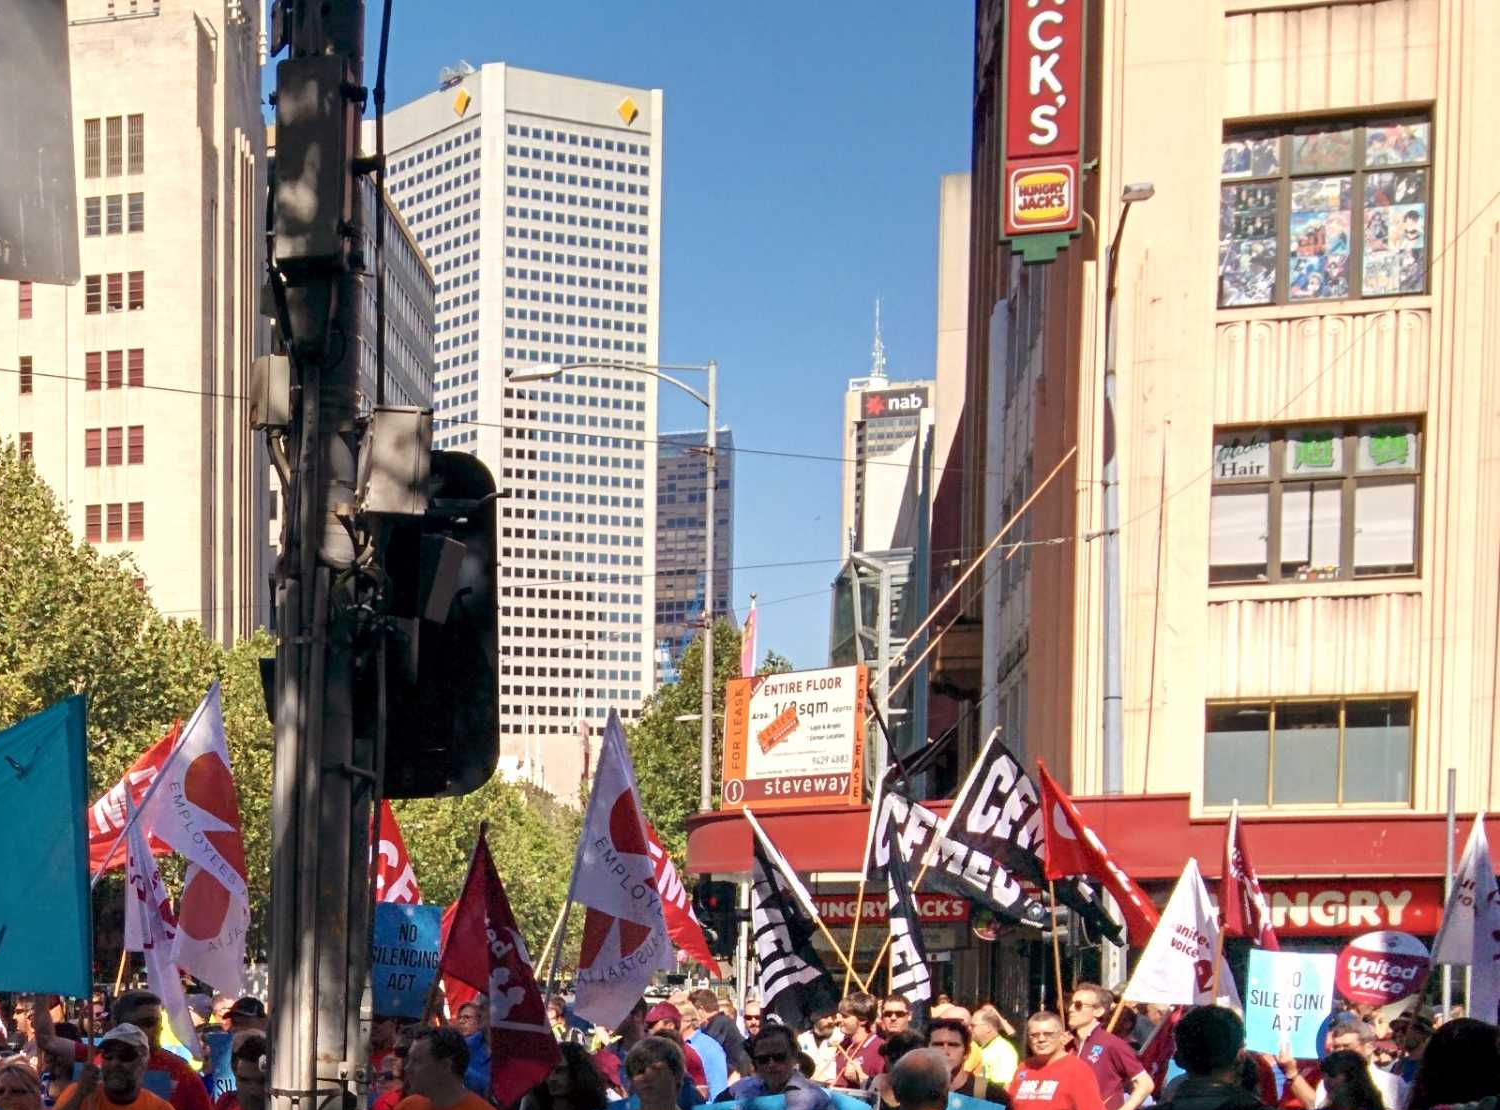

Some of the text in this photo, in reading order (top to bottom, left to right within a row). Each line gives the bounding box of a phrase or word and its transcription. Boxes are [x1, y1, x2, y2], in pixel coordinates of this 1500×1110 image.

[1026, 0, 1067, 146] CK'S
[1018, 182, 1066, 197] HUNGRY
[1018, 193, 1066, 211] JACK'S
[888, 393, 922, 411] nab
[1220, 460, 1265, 477] Hair
[764, 680, 803, 696] ENTIRE
[805, 677, 842, 692] FLOOR
[731, 686, 744, 770] FOR LEASE
[852, 674, 865, 798] FOR LEASE
[764, 776, 850, 795] steveway
[170, 782, 238, 886] EMPLOYEES
[399, 923, 418, 943] NO
[371, 946, 439, 970] SILENCING
[1347, 955, 1418, 980] United
[387, 975, 417, 993] ACT
[1349, 972, 1405, 994] Voice
